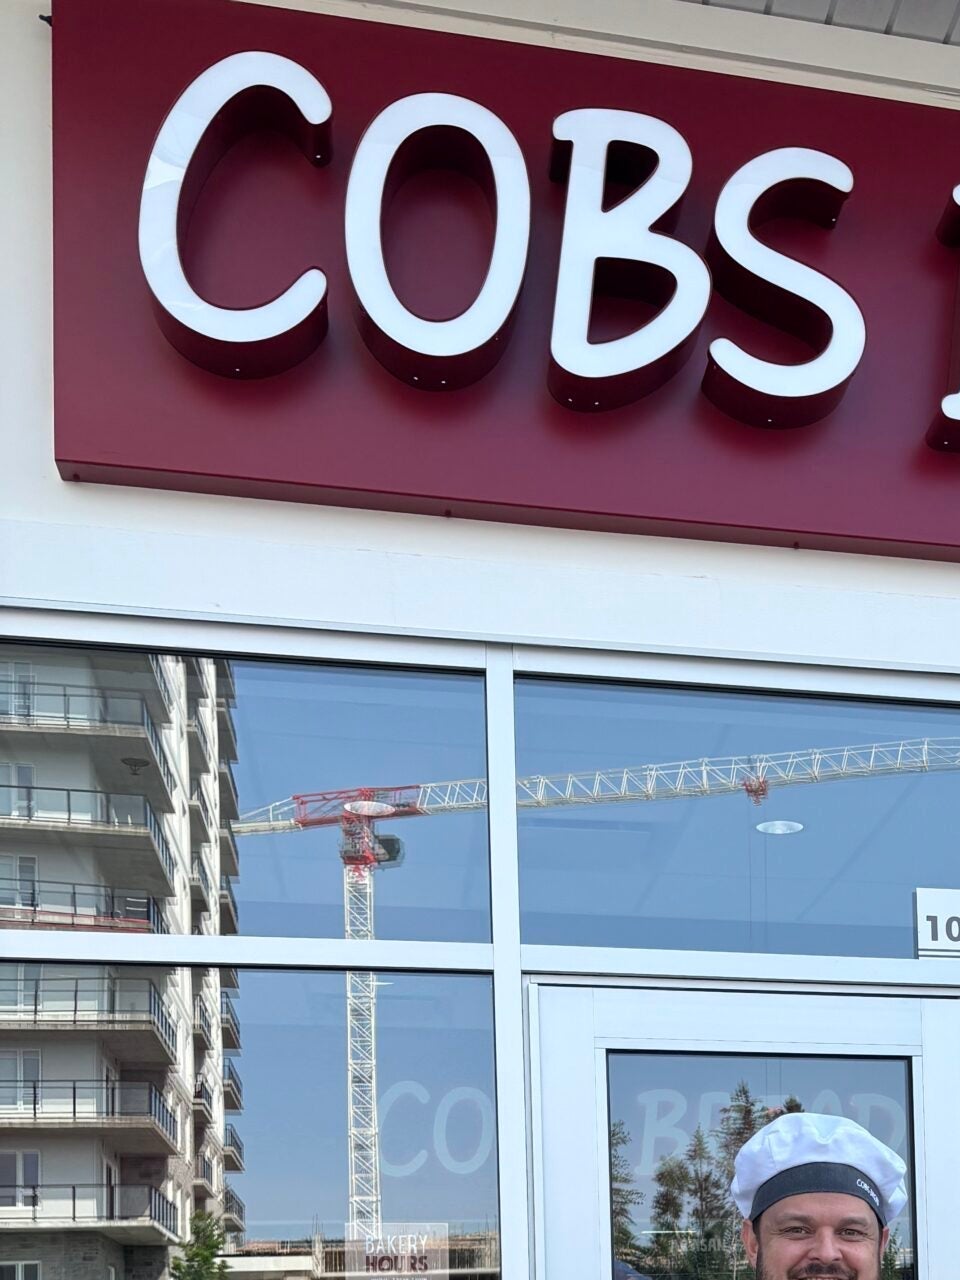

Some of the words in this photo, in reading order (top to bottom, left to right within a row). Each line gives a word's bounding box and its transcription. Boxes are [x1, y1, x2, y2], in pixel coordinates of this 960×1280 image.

[138, 50, 866, 398] COBS
[365, 1234, 428, 1254] BAKERY
[365, 1255, 428, 1273] HOURS
